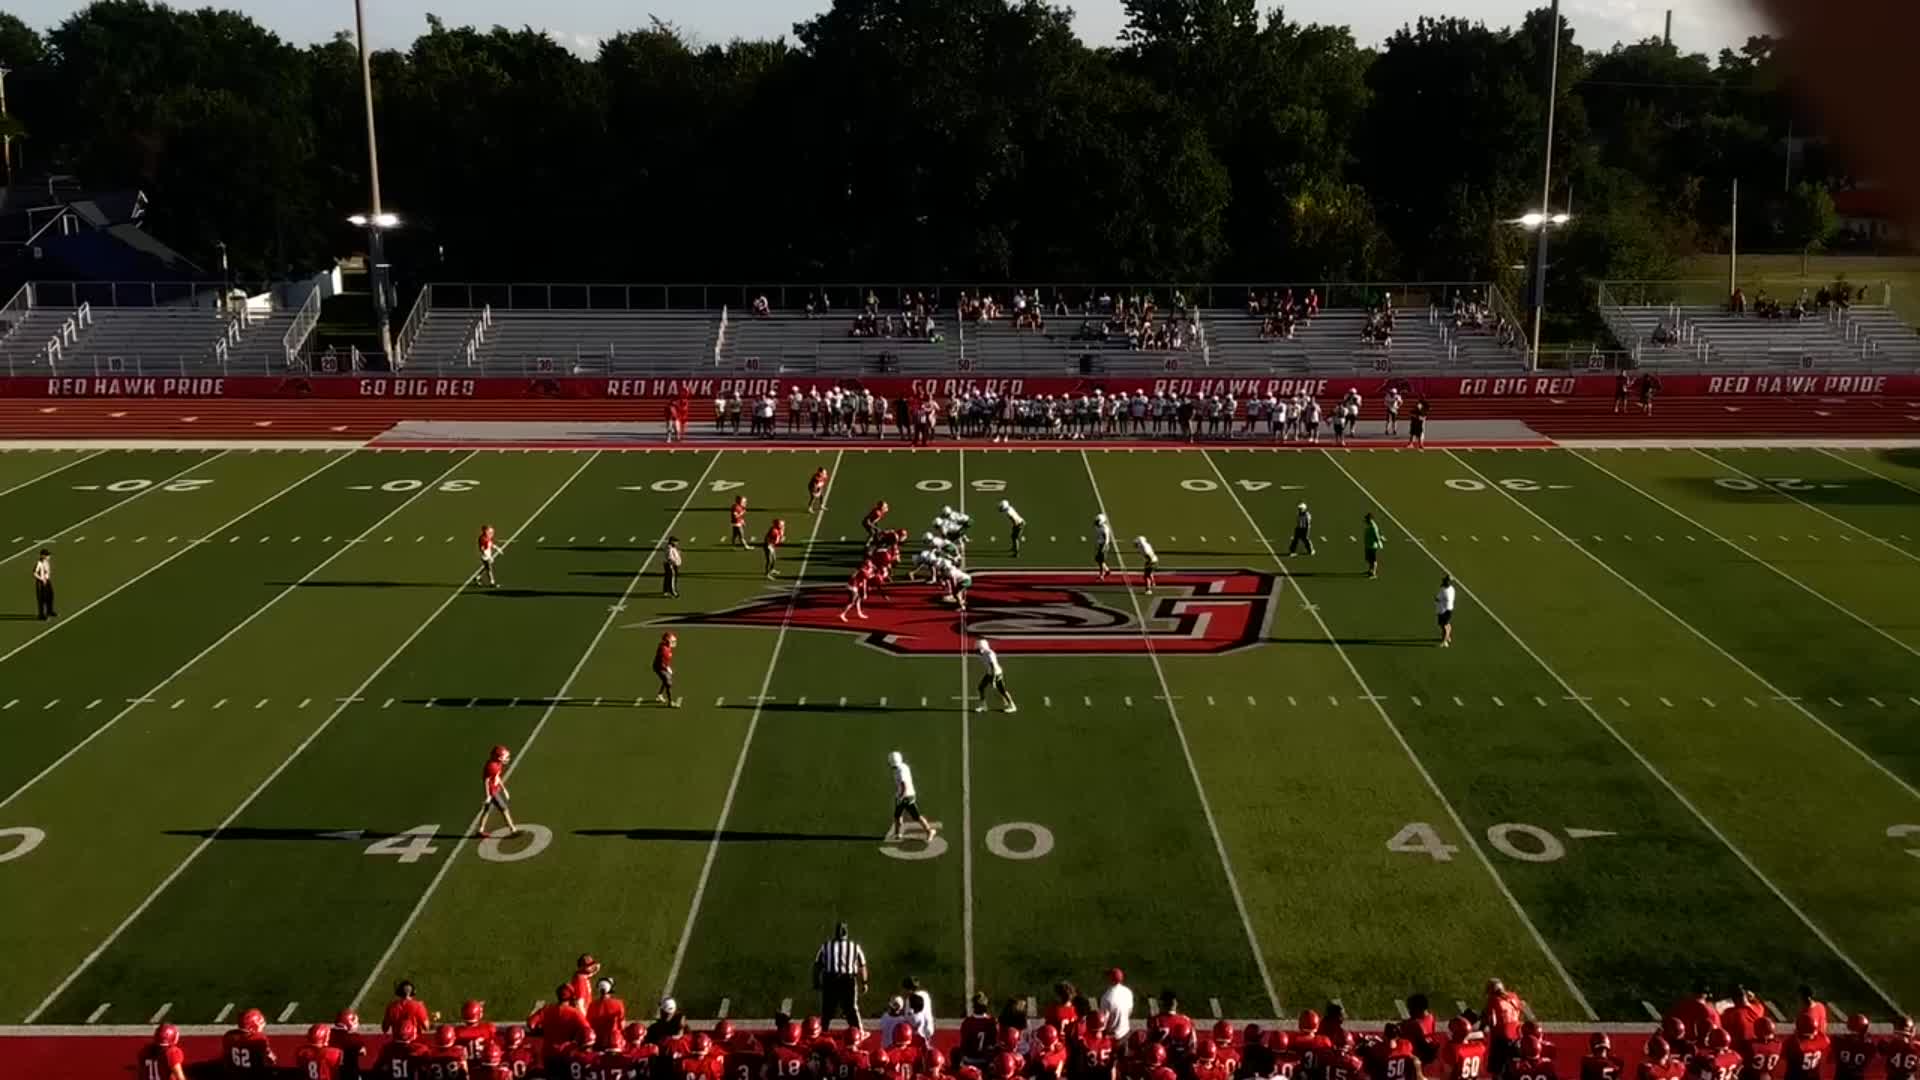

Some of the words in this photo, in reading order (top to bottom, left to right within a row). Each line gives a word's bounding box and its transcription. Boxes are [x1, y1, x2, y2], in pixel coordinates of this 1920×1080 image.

[48, 378, 86, 395] RED
[94, 378, 155, 395] HAWK
[163, 378, 224, 395] PRIDE
[360, 379, 386, 396] GO
[394, 379, 428, 396] BIG
[435, 379, 475, 396] RED
[607, 379, 645, 396] RED
[653, 379, 713, 396] HAWK
[719, 379, 781, 396] PRIDE
[1154, 379, 1193, 396] RED
[1200, 379, 1261, 396] HAWK
[1267, 379, 1328, 396] PRIDE
[1459, 378, 1486, 395] GO
[1493, 378, 1528, 395] BIG
[1535, 378, 1575, 395] RED
[1708, 376, 1748, 393] RED
[1755, 376, 1816, 393] HAWK
[1824, 376, 1887, 393] PRIDE
[231, 1047, 251, 1067] 62
[1752, 1053, 1780, 1070] 30
[392, 1058, 408, 1078] 51
[778, 1059, 800, 1078] 18
[1387, 1058, 1405, 1078] 50
[1461, 1055, 1480, 1078] 60
